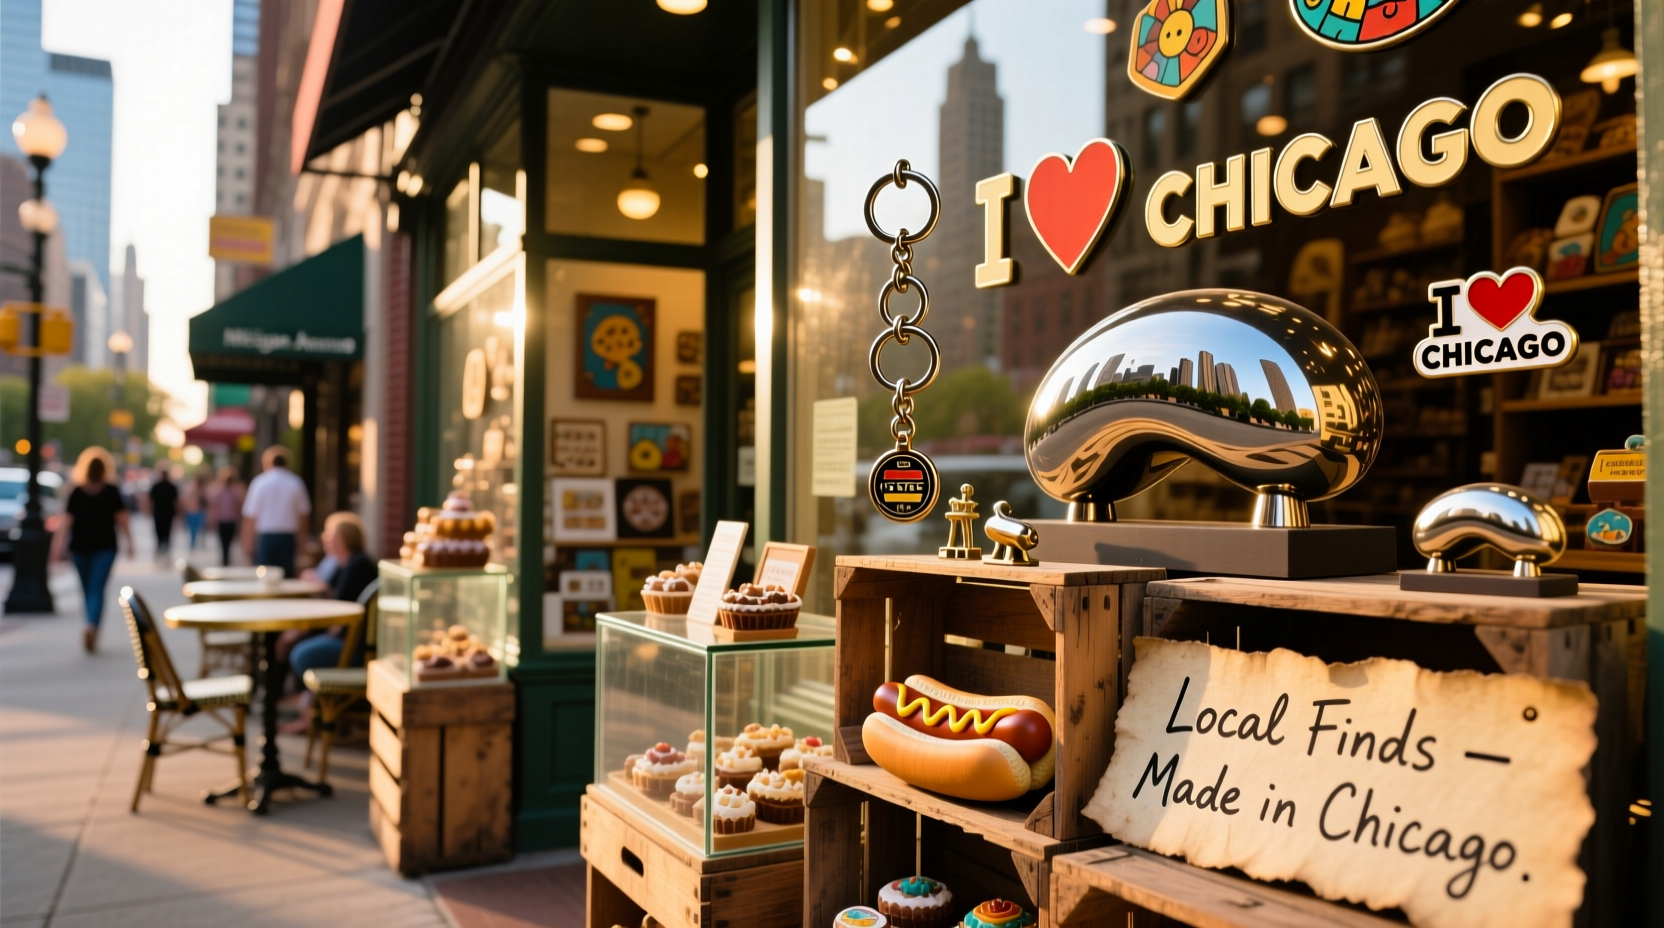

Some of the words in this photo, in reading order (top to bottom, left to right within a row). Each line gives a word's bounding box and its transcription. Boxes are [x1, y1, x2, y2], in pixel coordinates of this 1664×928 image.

[975, 172, 1014, 288] I
[1145, 73, 1562, 247] CHICAGO
[1422, 331, 1565, 369] CHICAGO
[1433, 285, 1461, 338] I
[1166, 676, 1289, 746] Local
[1307, 699, 1437, 771] Finds
[1132, 751, 1242, 816] Made
[1260, 784, 1297, 828] in
[1319, 782, 1531, 899] Chicago.
